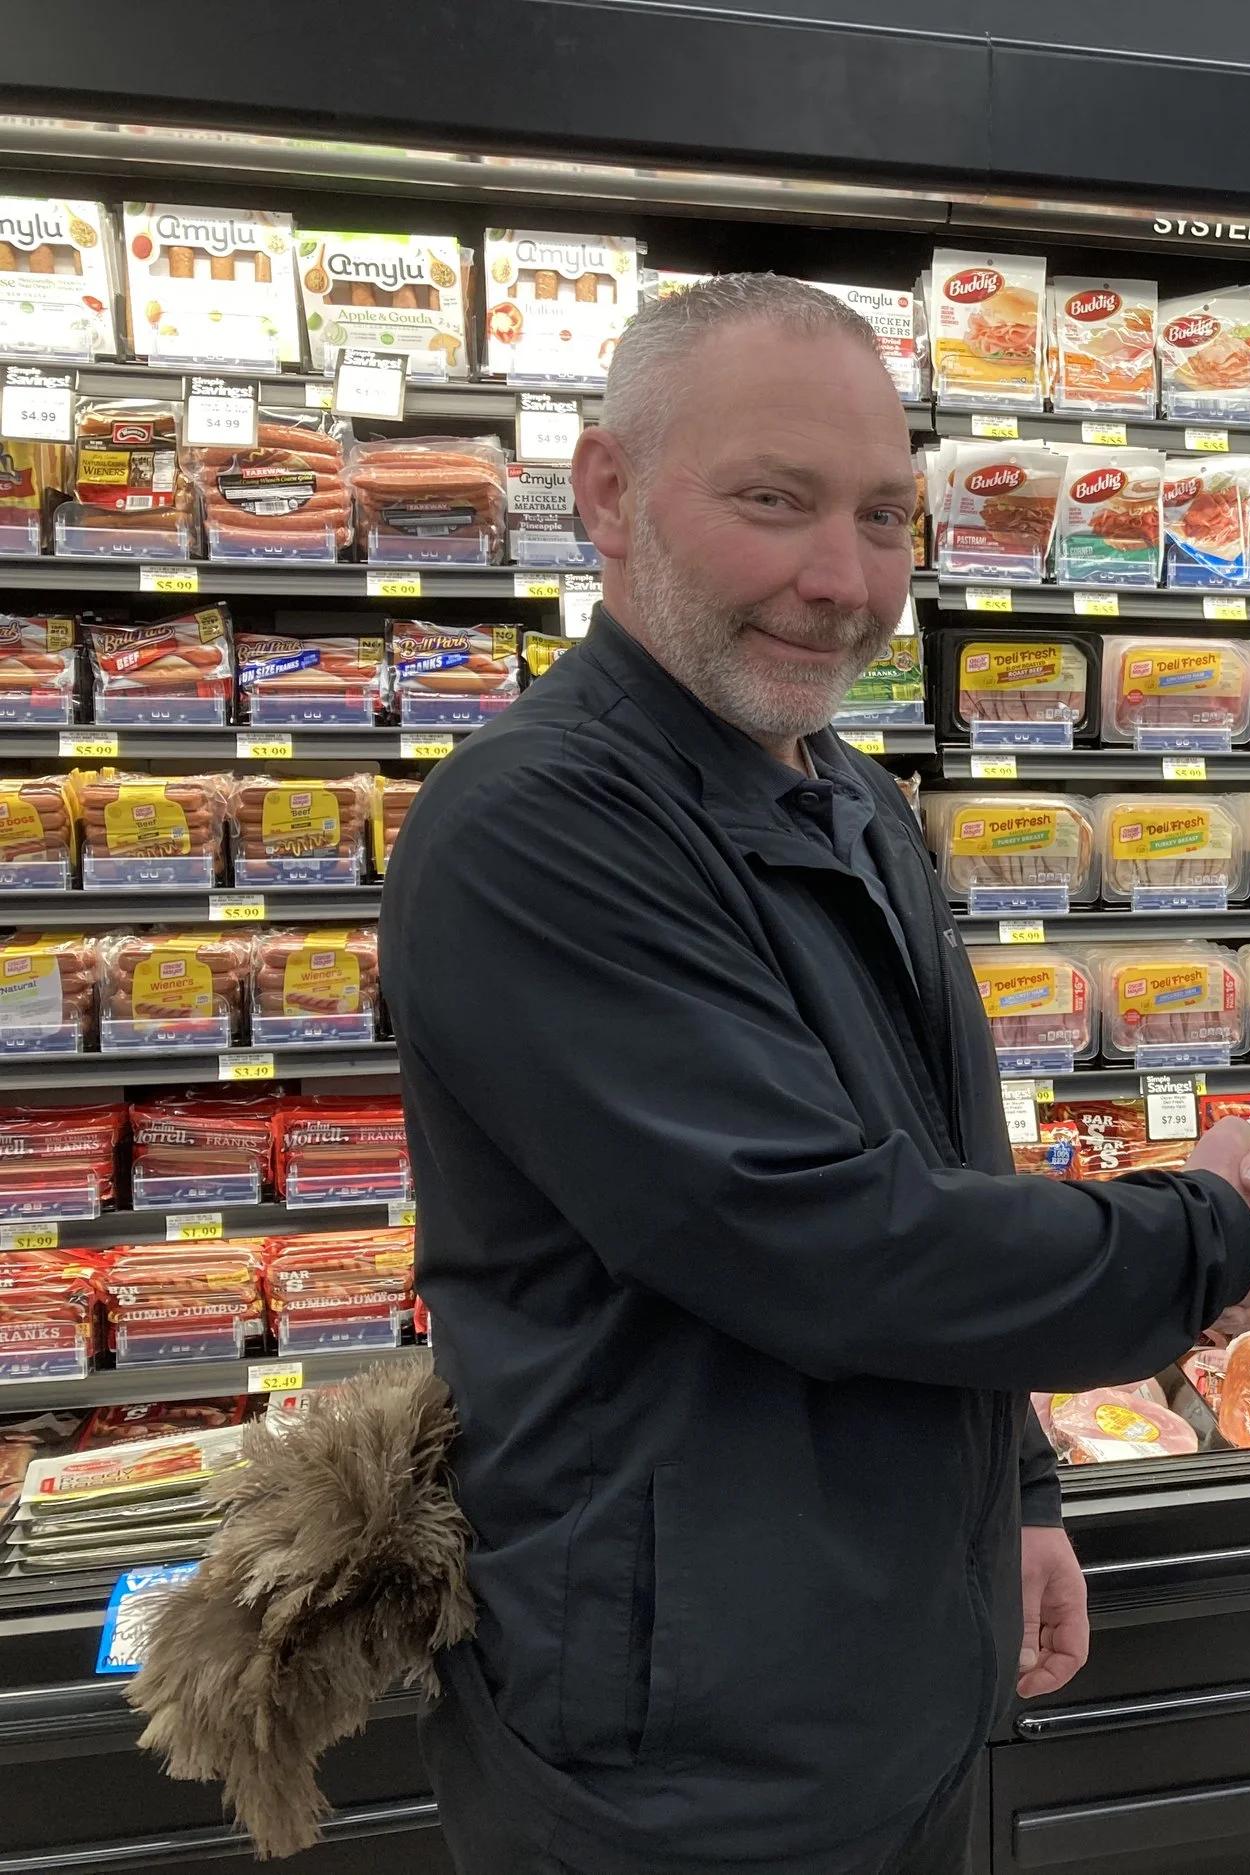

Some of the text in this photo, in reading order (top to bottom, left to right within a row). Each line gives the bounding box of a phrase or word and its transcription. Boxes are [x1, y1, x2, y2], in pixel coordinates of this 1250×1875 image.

[0, 213, 63, 246] mylu
[156, 215, 255, 251] amylu
[515, 240, 604, 274] amylu
[327, 253, 425, 287] amylu
[949, 274, 998, 297] Buddig
[848, 290, 893, 309] amylu
[1071, 294, 1117, 316] Buddig
[338, 309, 433, 325] Apple & Gouda
[344, 355, 402, 370] Savings!
[6, 366, 41, 376] Simple
[6, 374, 71, 389] Savings!
[192, 377, 225, 387] Simple
[192, 384, 253, 398] Savings!
[521, 393, 551, 403] Simple
[521, 400, 577, 414] Savings!
[21, 410, 57, 422] $4.99
[84, 466, 125, 476] WIENERS
[519, 471, 566, 489] amylu
[970, 469, 1020, 490] Buddig
[1075, 471, 1123, 497] Buddig
[514, 495, 566, 503] CHICKEN
[514, 503, 567, 511] MEATBALLS
[519, 522, 563, 532] Pineapple
[957, 535, 987, 546] PASTRAMI
[564, 574, 594, 583] Simple
[156, 581, 193, 591] $5.99
[382, 585, 415, 594] $5.99
[564, 581, 603, 592] Savin
[401, 632, 470, 657] Ball Park
[116, 651, 140, 670] BEEF
[969, 656, 988, 665] Oscar
[994, 647, 1057, 667] Deli Fresh
[1157, 653, 1216, 672] Deli Fresh
[256, 660, 299, 678] SIZE FRANKS
[968, 662, 988, 671] Mayer
[1133, 662, 1150, 670] Oscar
[1132, 668, 1151, 677] Mayer
[76, 745, 113, 755] $5.99
[252, 747, 287, 756] $3.99
[415, 747, 448, 757] $3.99
[291, 808, 311, 817] Beef
[7, 816, 35, 826] DOGS
[136, 820, 156, 829] Beef
[964, 822, 983, 831] Oscar
[989, 815, 1051, 833] Deli Fresh
[1146, 816, 1205, 835] Deli Fresh
[963, 829, 984, 838] Mayer
[1122, 825, 1141, 834] Oscar
[1122, 832, 1141, 841] Mayer
[224, 908, 260, 919] $5.99
[1012, 931, 1040, 942] $5.99
[301, 967, 345, 982] Wieners
[1151, 970, 1202, 991] Deli Fresh
[150, 977, 194, 991] Wieners
[995, 971, 1049, 992] Deli Fresh
[1127, 982, 1145, 990] Oscar
[0, 981, 37, 995] Natural
[1127, 987, 1146, 997] Mayer
[234, 1066, 269, 1078] $3.49
[1147, 1075, 1171, 1083] Simple
[1148, 1081, 1193, 1094] Savings!
[1082, 1114, 1114, 1127] BAR
[1162, 1115, 1187, 1125] $7.99
[360, 1129, 409, 1142] FRANKS
[1088, 1124, 1105, 1144] S
[1093, 1141, 1124, 1152] BAR
[1100, 1150, 1119, 1170] S
[182, 1226, 217, 1238] $1.99
[16, 1237, 53, 1248] $1.99
[280, 1271, 310, 1280] BAR
[108, 1286, 139, 1295] BAR
[286, 1279, 303, 1293] S
[287, 1291, 406, 1311] JUMBO JUMBOS
[124, 1303, 248, 1321] JUMBO JUMBOS
[0, 1327, 60, 1342] RANKS
[263, 1376, 297, 1388] $2.49
